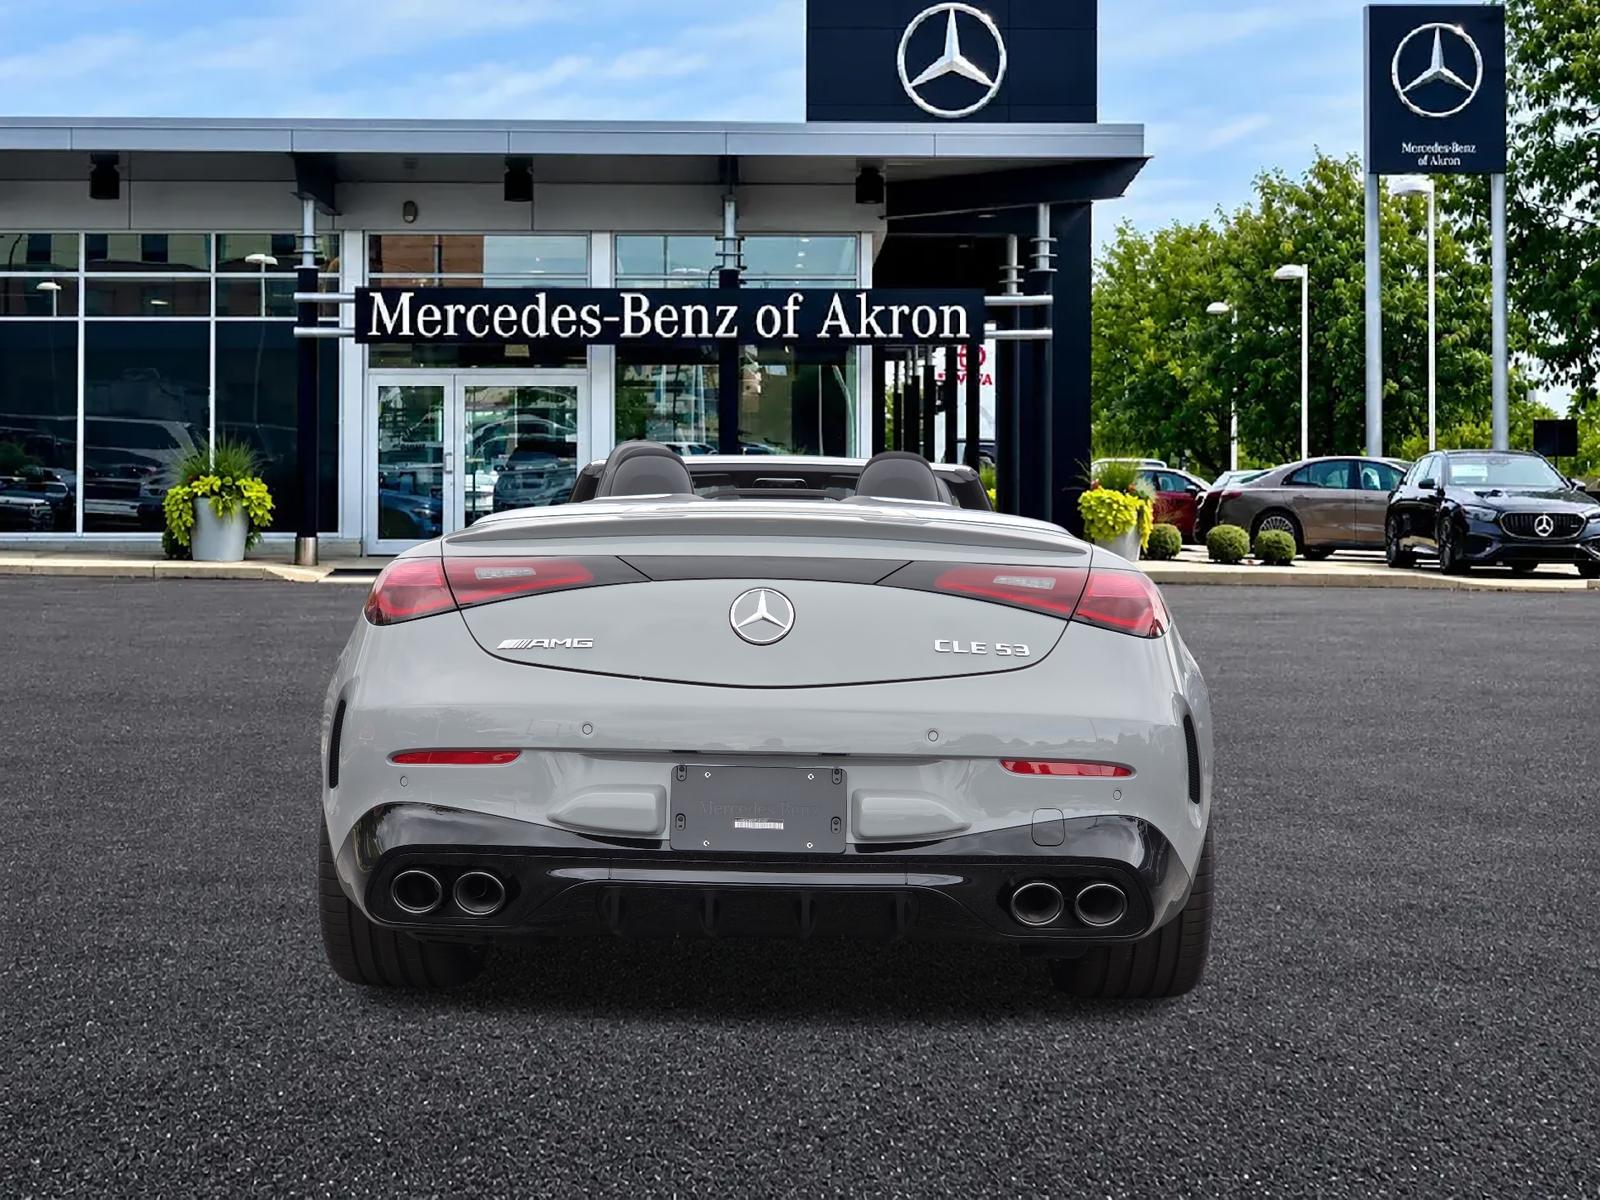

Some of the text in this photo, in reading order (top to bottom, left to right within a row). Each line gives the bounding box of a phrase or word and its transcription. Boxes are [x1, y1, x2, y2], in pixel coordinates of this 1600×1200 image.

[1401, 142, 1476, 153] Mercedes-Benz
[1417, 154, 1460, 165] of Akron
[367, 291, 970, 338] Mercedes-Benz of Akron
[934, 639, 1031, 657] CLE 53
